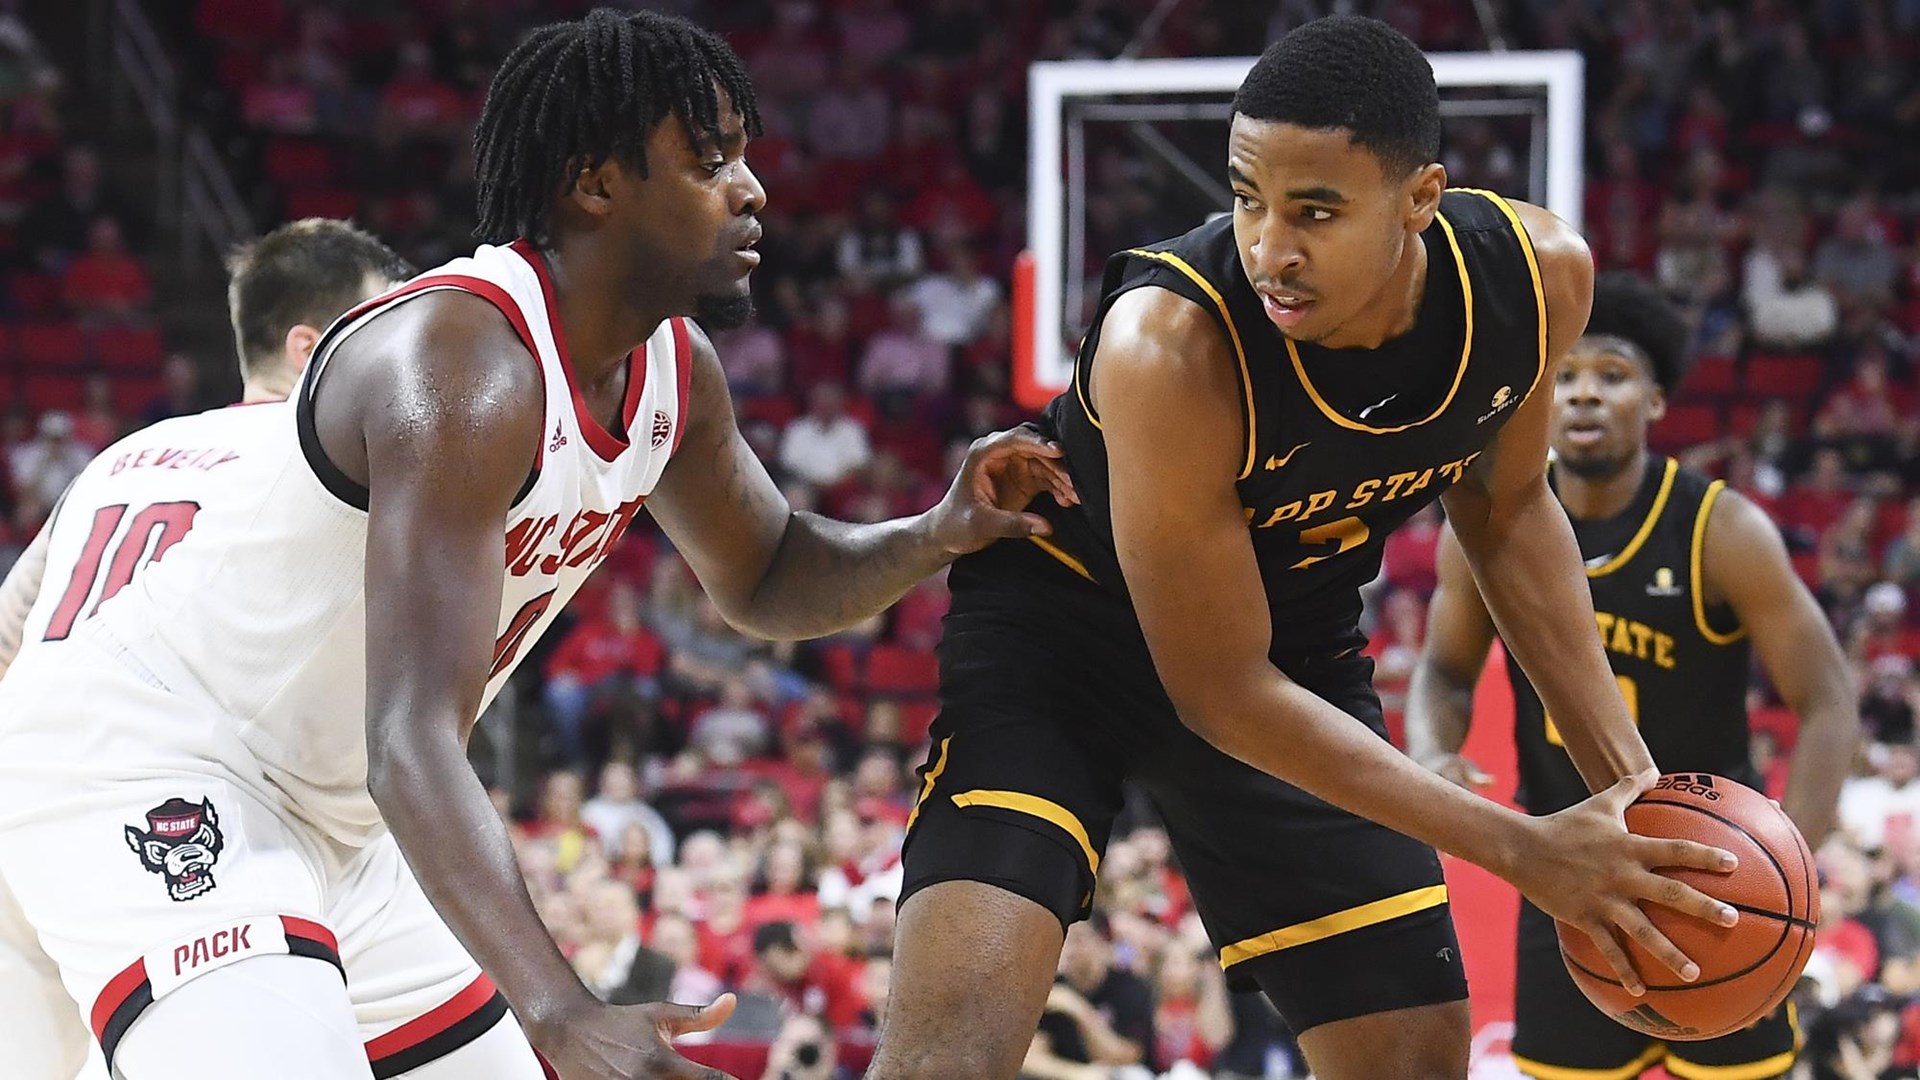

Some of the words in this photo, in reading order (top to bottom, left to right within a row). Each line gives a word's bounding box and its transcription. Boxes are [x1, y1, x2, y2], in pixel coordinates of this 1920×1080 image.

[1242, 489, 1337, 530] PP
[1345, 450, 1482, 510] STAT
[41, 500, 202, 643] 10
[1593, 610, 1677, 671] TATE
[156, 821, 170, 832] NC
[170, 817, 196, 832] STATE
[173, 924, 252, 977] PACK
